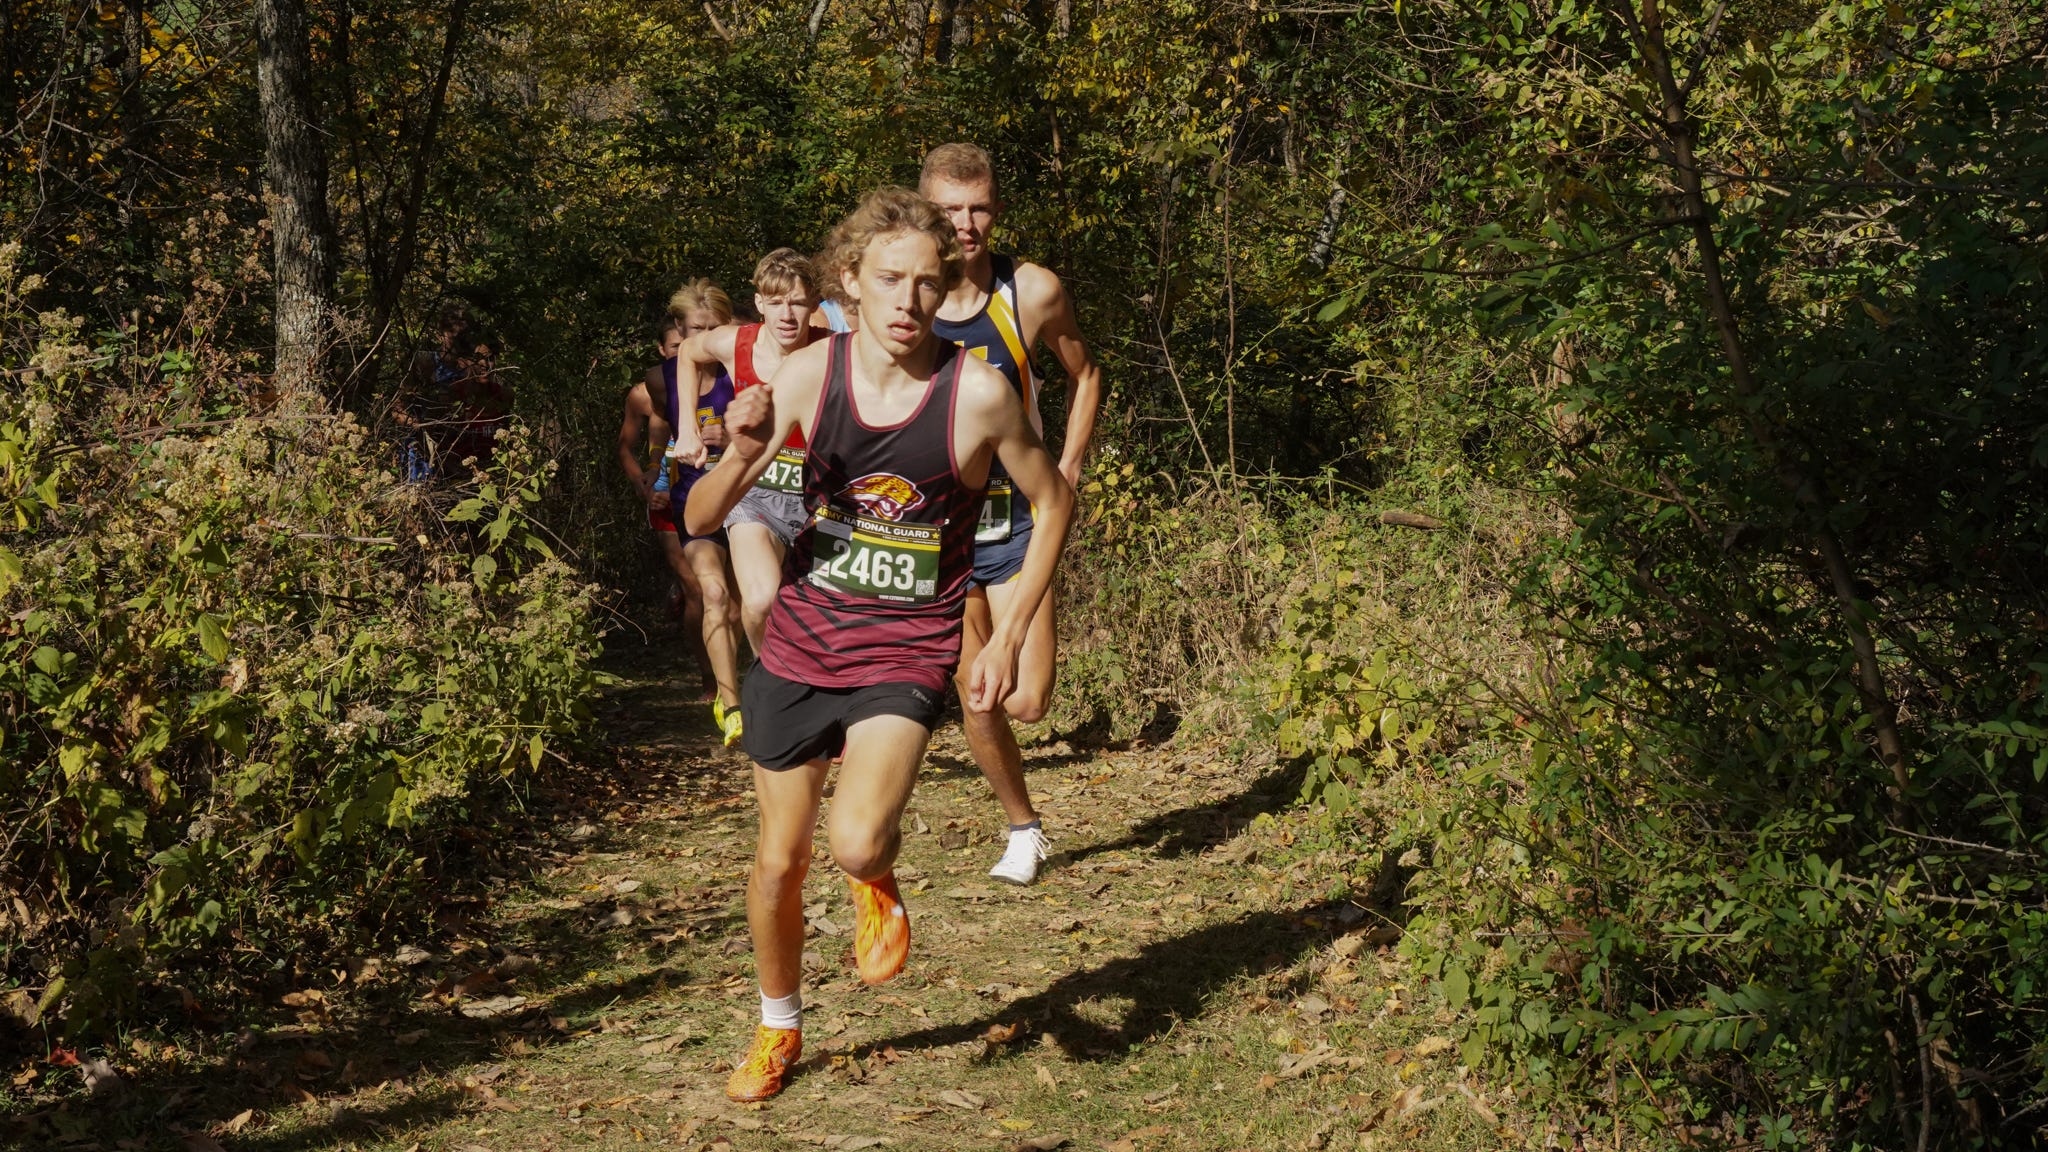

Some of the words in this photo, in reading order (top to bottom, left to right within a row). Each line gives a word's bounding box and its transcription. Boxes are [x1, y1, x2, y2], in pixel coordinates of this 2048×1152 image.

[758, 461, 803, 487] 473
[816, 508, 842, 521] ARMY
[843, 516, 892, 534] NATIONAL
[893, 527, 930, 539] GUARD
[830, 539, 915, 590] 2463
